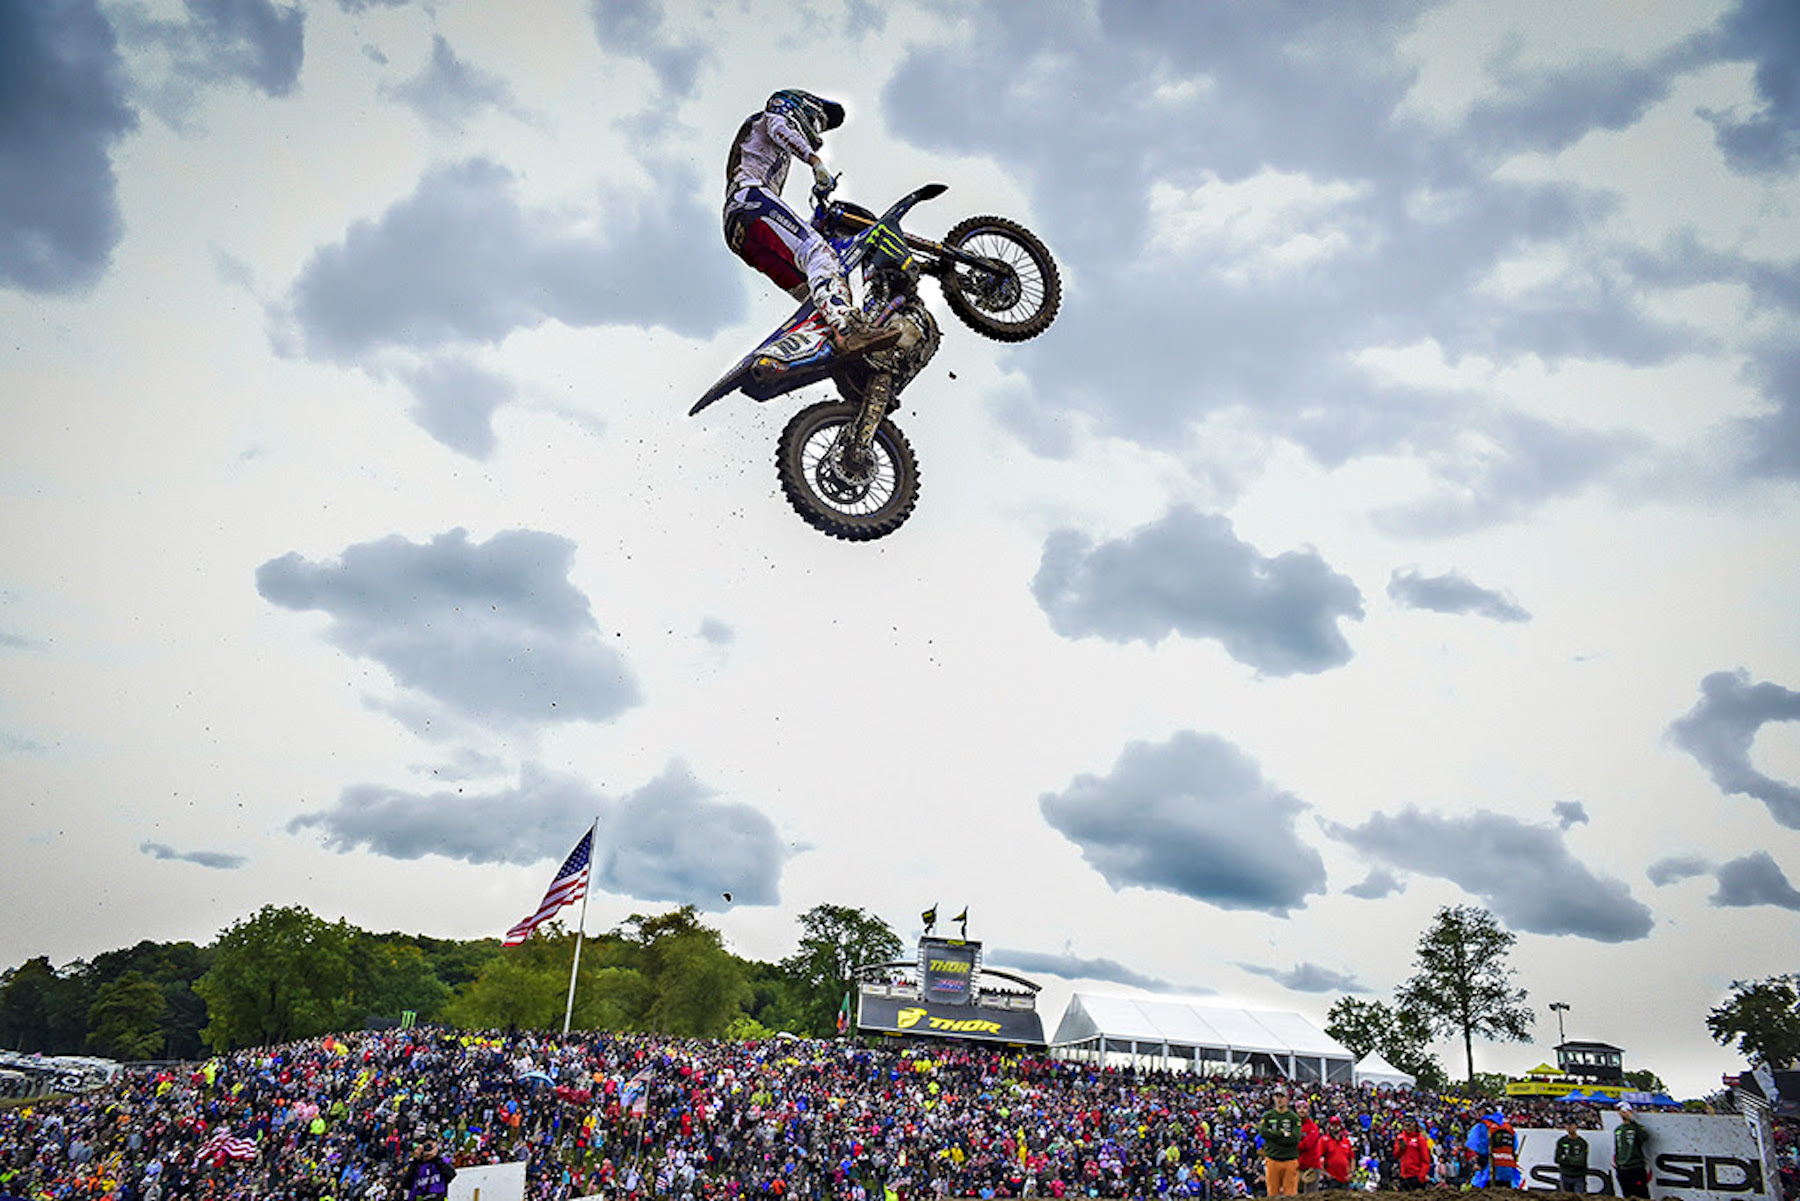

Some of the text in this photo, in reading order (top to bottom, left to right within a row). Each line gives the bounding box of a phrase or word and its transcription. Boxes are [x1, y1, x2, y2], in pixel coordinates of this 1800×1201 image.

[929, 960, 970, 973] THOR
[928, 1016, 1002, 1034] THOR
[1656, 1154, 1765, 1194] SIDI
